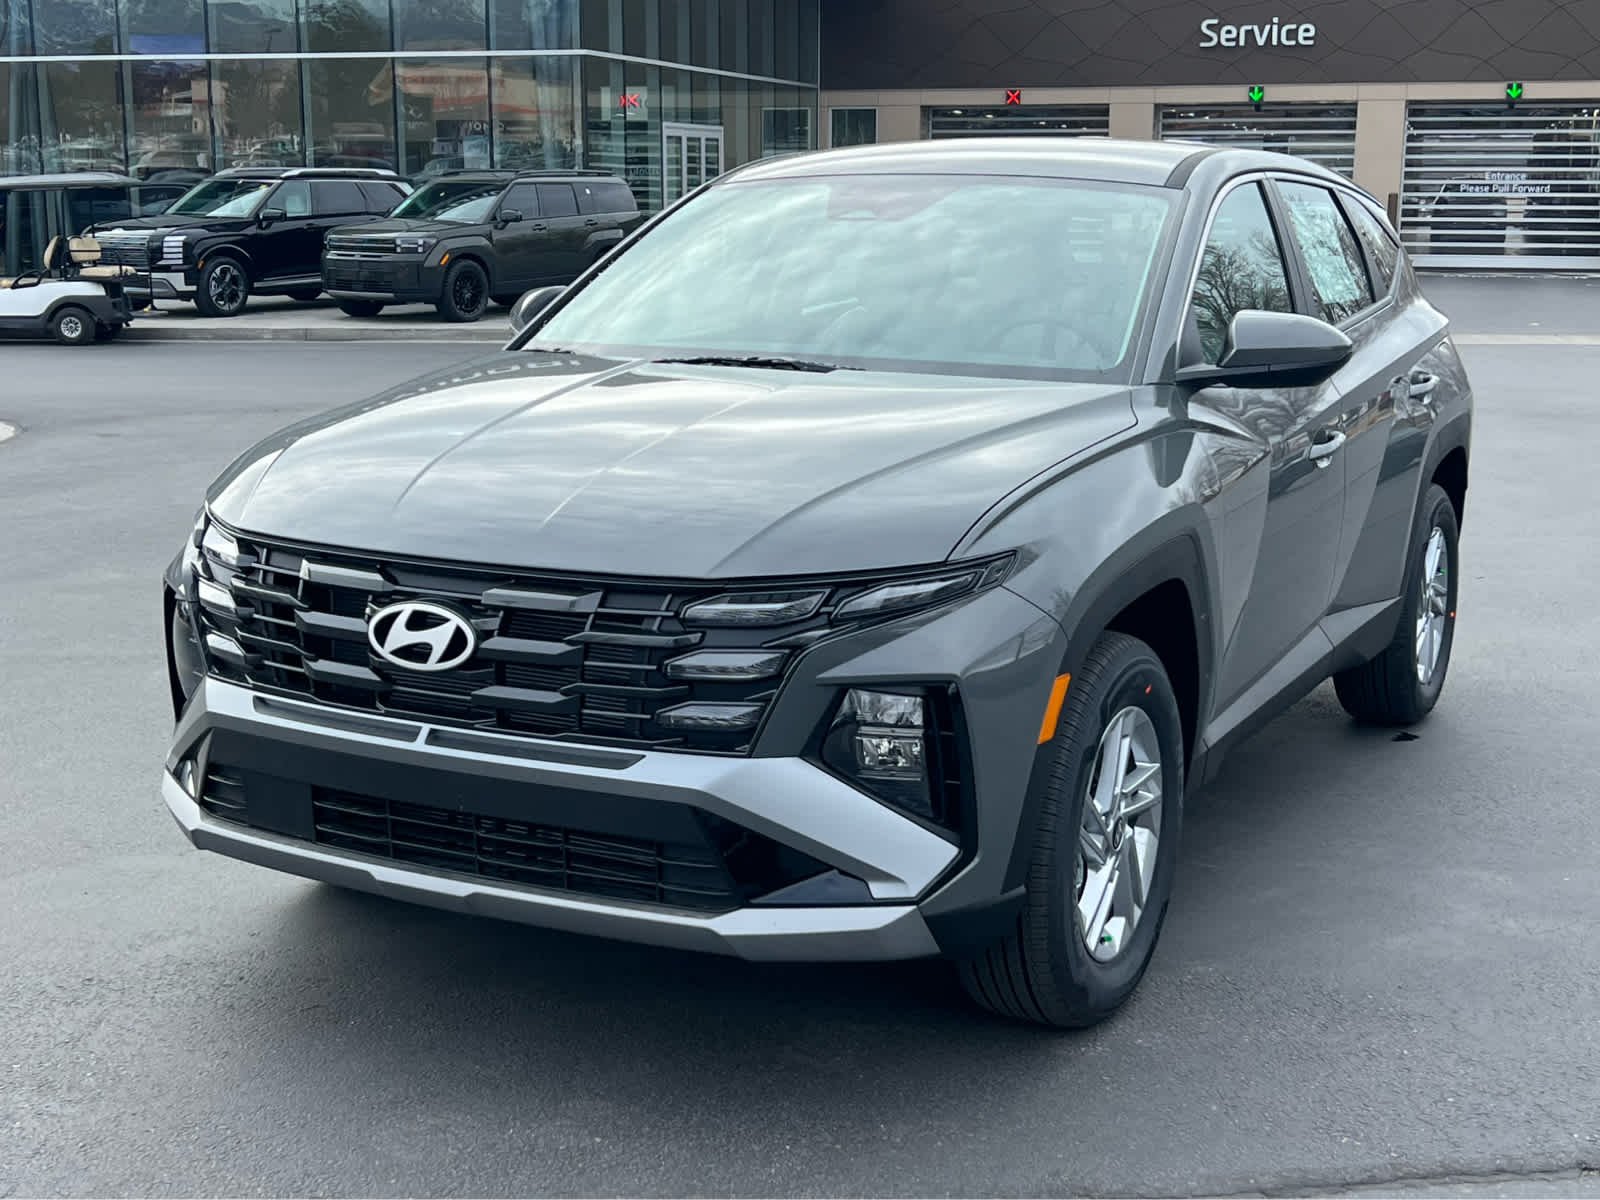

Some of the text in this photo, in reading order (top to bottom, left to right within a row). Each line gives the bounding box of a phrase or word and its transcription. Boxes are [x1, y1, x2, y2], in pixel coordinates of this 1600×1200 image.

[1199, 16, 1316, 48] Service
[1484, 171, 1528, 181] Entrance
[1459, 183, 1551, 193] Please Pull Forward
